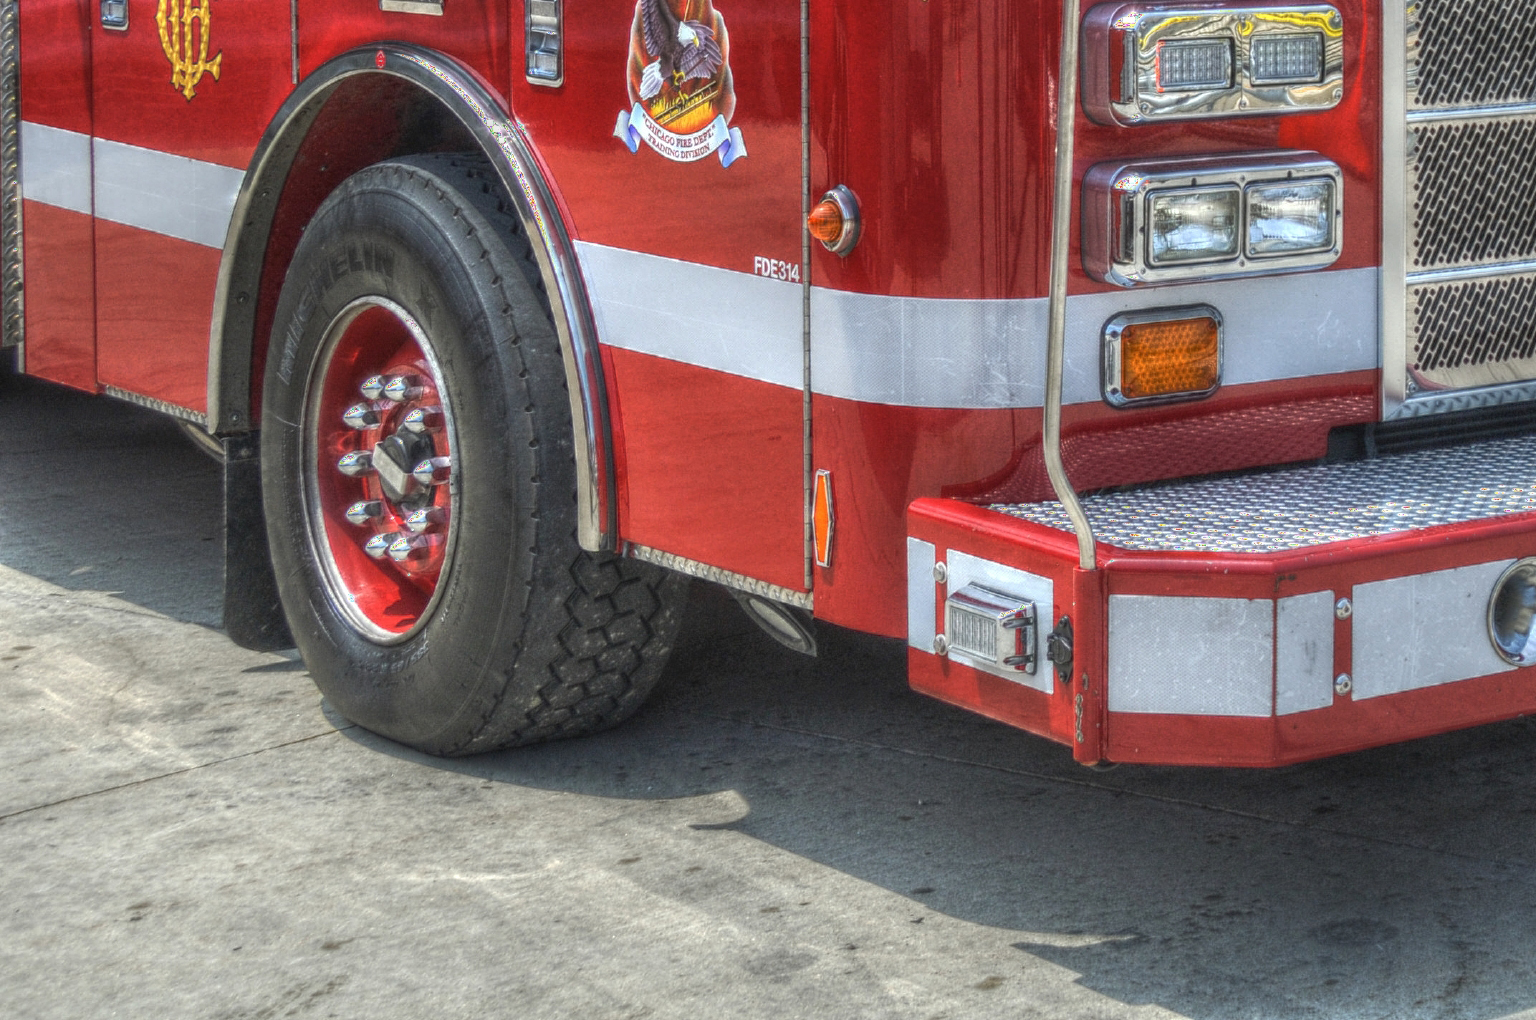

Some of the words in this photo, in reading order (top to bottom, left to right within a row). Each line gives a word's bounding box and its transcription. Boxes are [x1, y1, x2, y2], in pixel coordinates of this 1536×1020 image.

[648, 133, 680, 159] TRAINING
[680, 143, 711, 160] DIVISION
[676, 138, 693, 149] FIRE
[754, 255, 800, 283] FDE314
